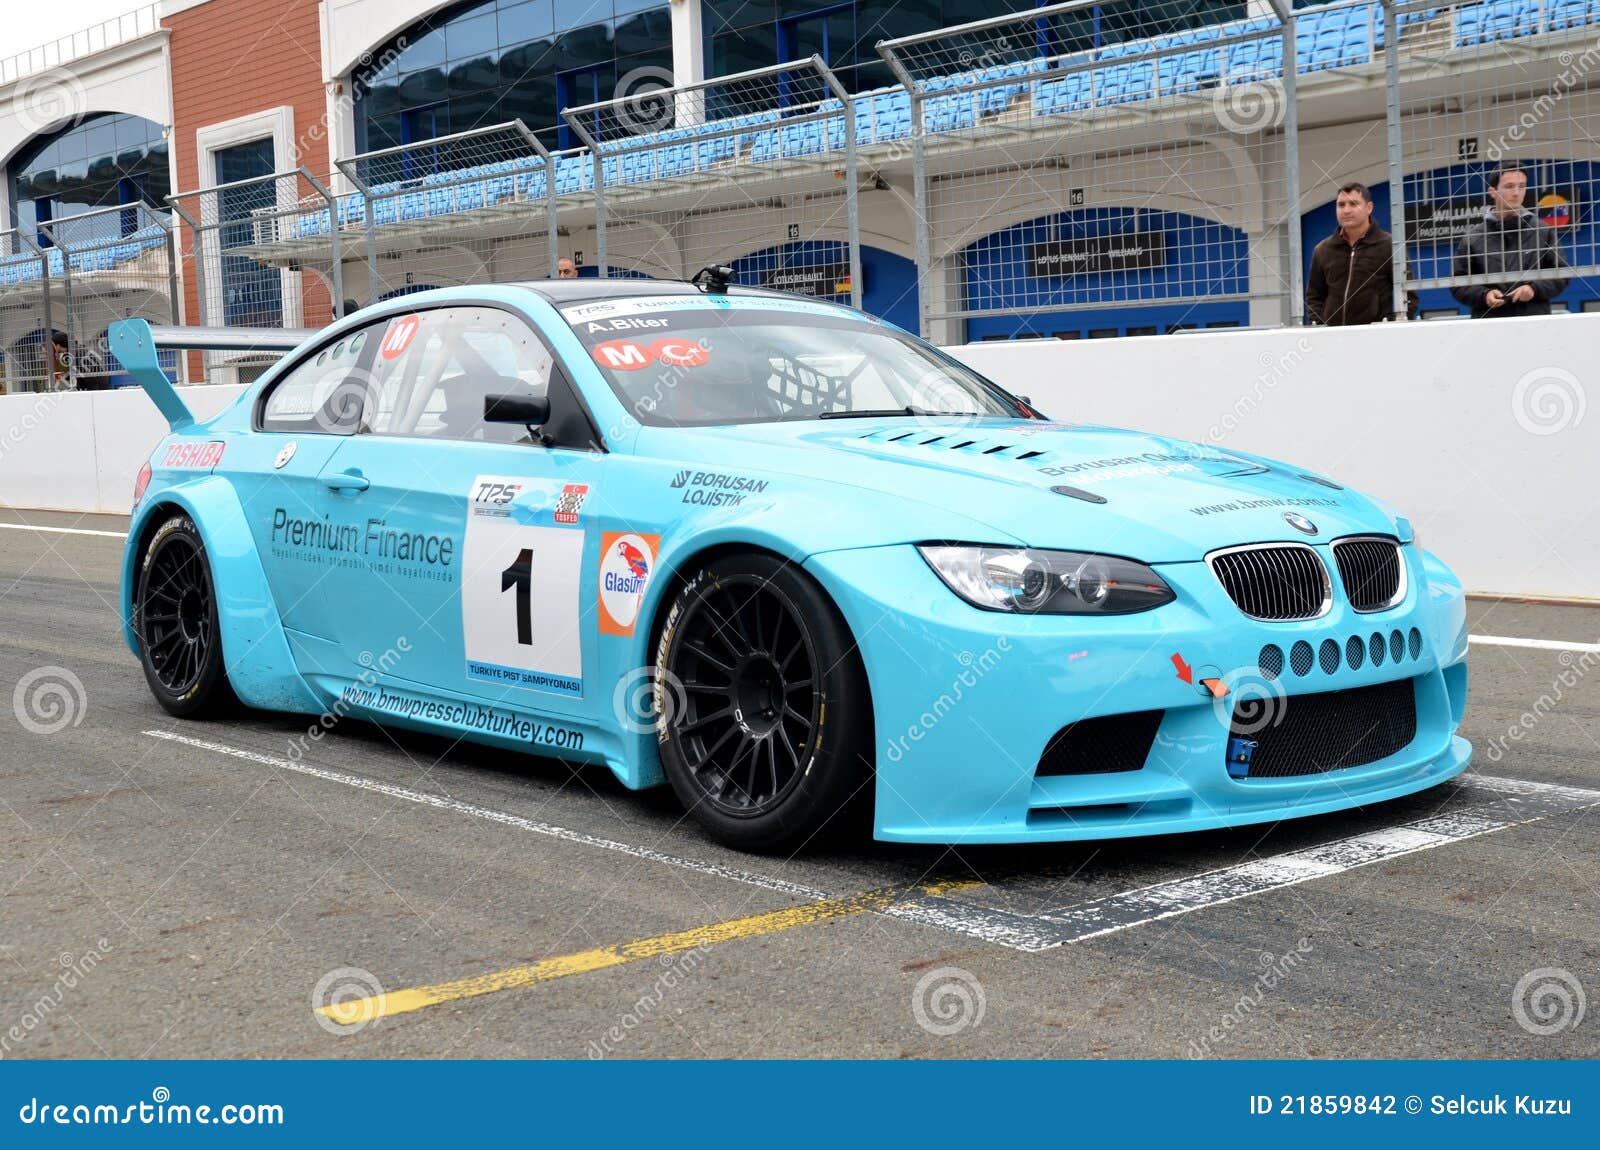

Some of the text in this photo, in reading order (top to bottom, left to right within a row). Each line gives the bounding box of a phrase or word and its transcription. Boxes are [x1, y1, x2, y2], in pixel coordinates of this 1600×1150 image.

[1071, 192, 1083, 204] 16
[384, 321, 416, 351] M
[587, 314, 669, 334] A.Biter
[600, 344, 648, 367] M
[160, 440, 227, 467] TOSHIBA
[1037, 454, 1142, 478] Borusan
[475, 483, 516, 505] TPS
[691, 471, 770, 493] BORUSAN
[271, 507, 454, 567] Premium Finance
[501, 548, 534, 646] 1
[342, 684, 585, 750] www.bmwpressclubturkey.com
